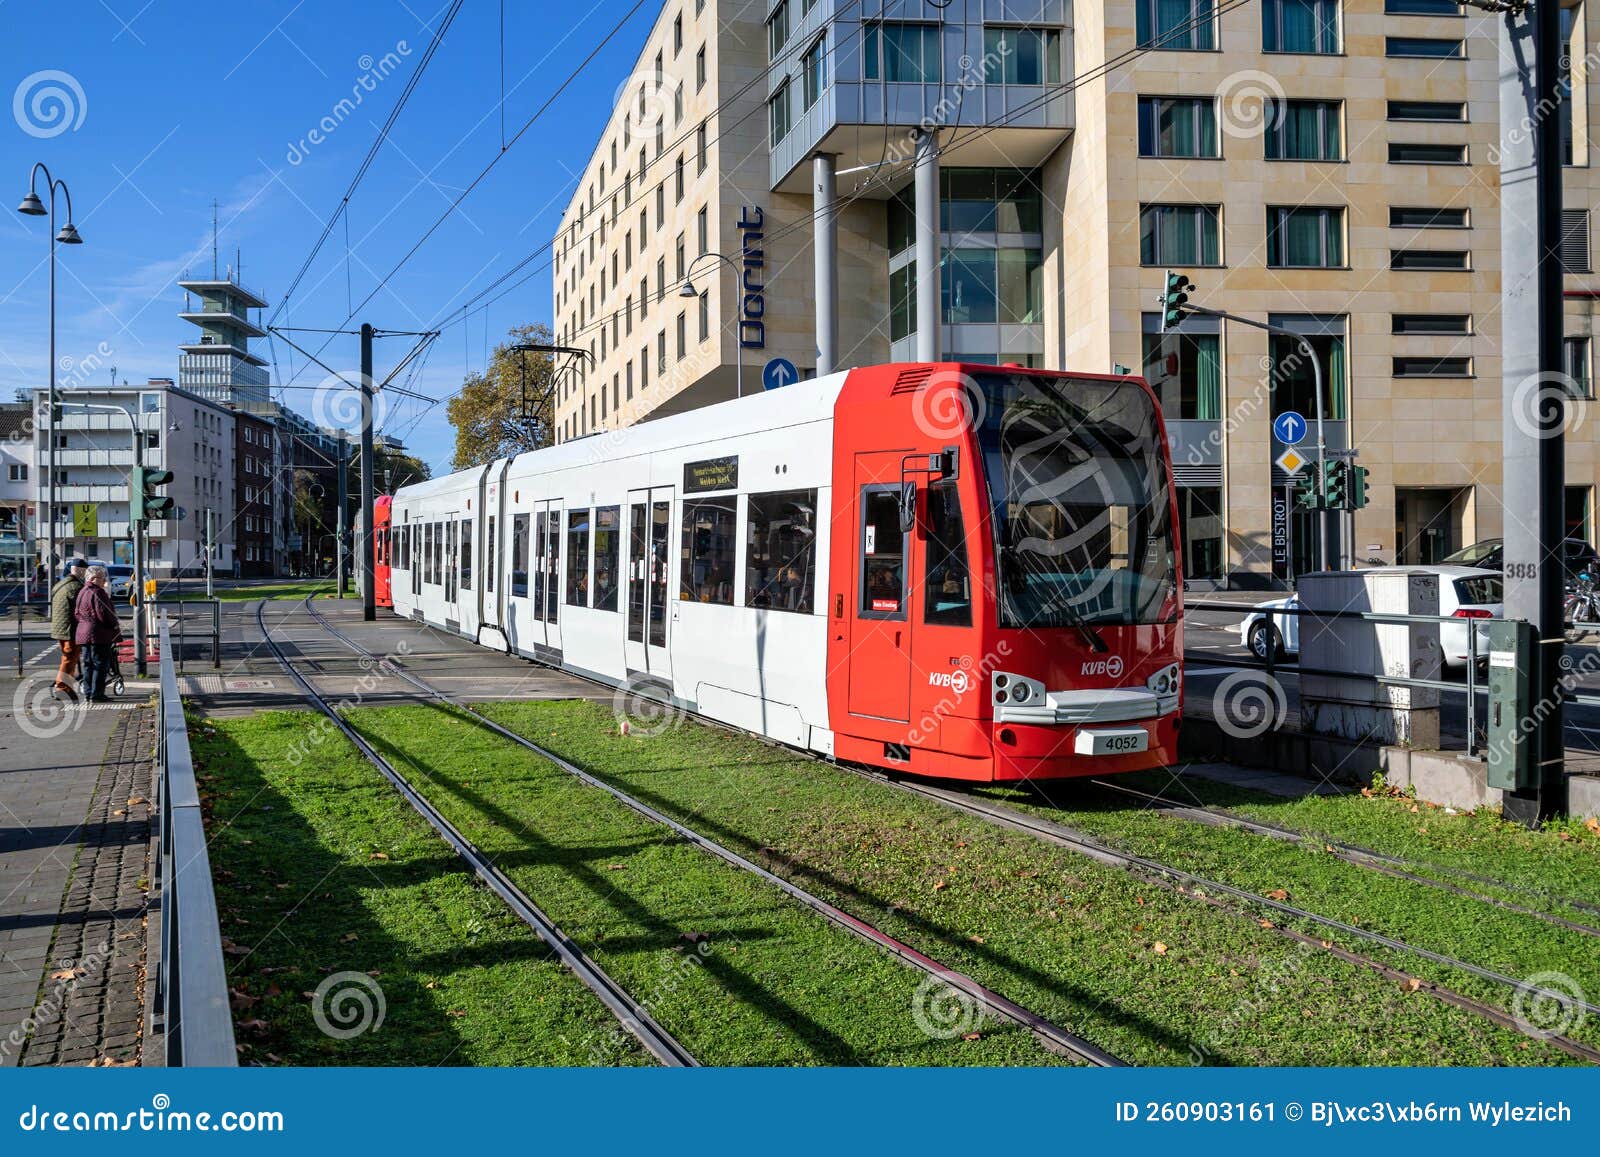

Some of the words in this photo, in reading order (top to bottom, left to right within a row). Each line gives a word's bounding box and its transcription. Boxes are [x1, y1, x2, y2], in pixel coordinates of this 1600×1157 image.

[737, 205, 765, 349] Dorint
[1274, 497, 1286, 546] BISTROT
[1274, 549, 1286, 563] LE
[1506, 562, 1537, 580] 388
[1081, 661, 1106, 675] KVB
[929, 671, 951, 687] KVB
[1105, 736, 1138, 750] 4052
